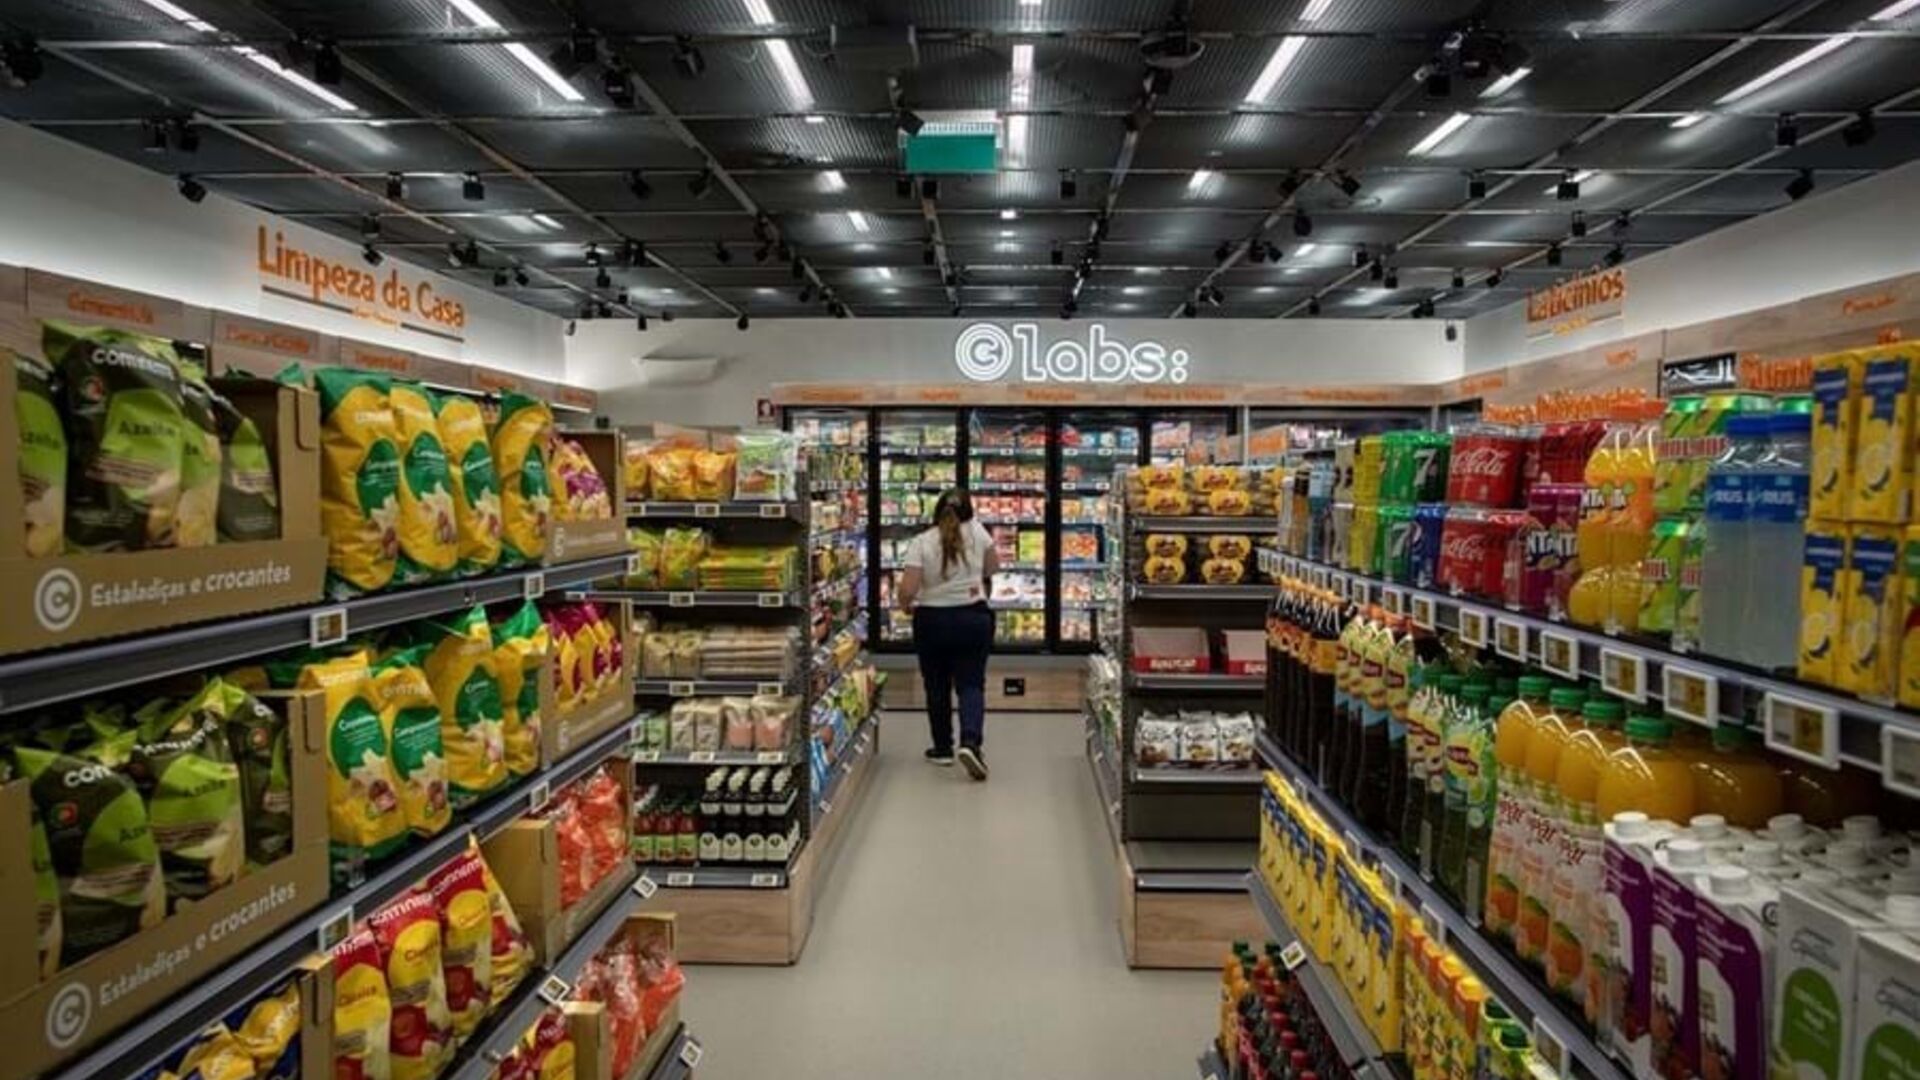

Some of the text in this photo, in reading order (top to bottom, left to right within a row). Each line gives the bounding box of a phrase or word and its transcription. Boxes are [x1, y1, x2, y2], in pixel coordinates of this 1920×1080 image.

[258, 225, 375, 300] Limpeza
[381, 269, 411, 312] da
[415, 281, 465, 327] Casa
[90, 577, 185, 608] Estaladiças
[190, 577, 202, 593] e
[205, 560, 291, 591] crocantes
[194, 932, 207, 951] e
[209, 881, 297, 943] crocantes
